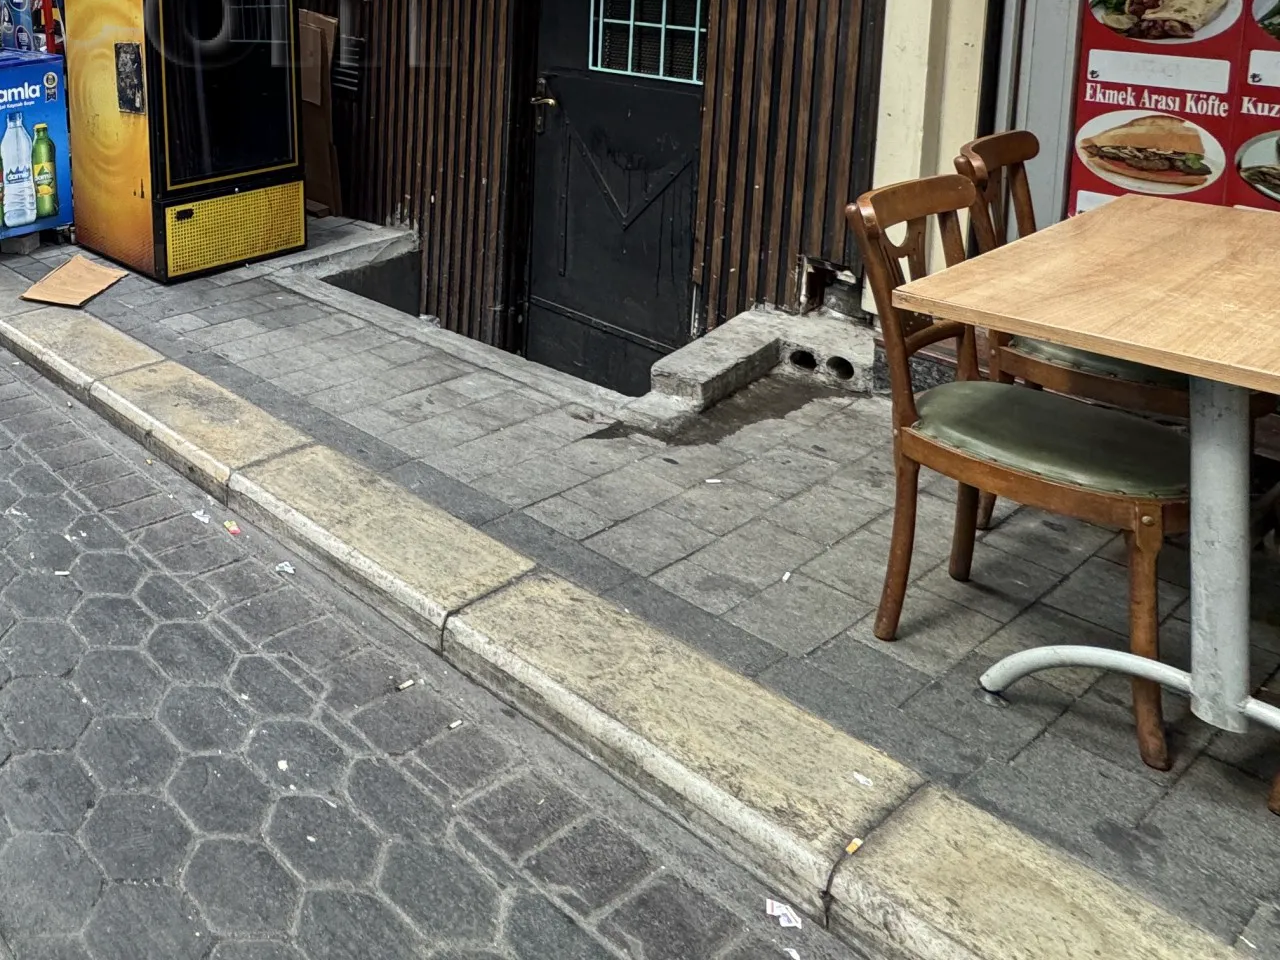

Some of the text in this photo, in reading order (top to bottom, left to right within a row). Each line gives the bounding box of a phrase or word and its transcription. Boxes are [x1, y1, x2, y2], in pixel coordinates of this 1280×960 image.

[1084, 82, 1229, 117] Ekmek Arası Köfte
